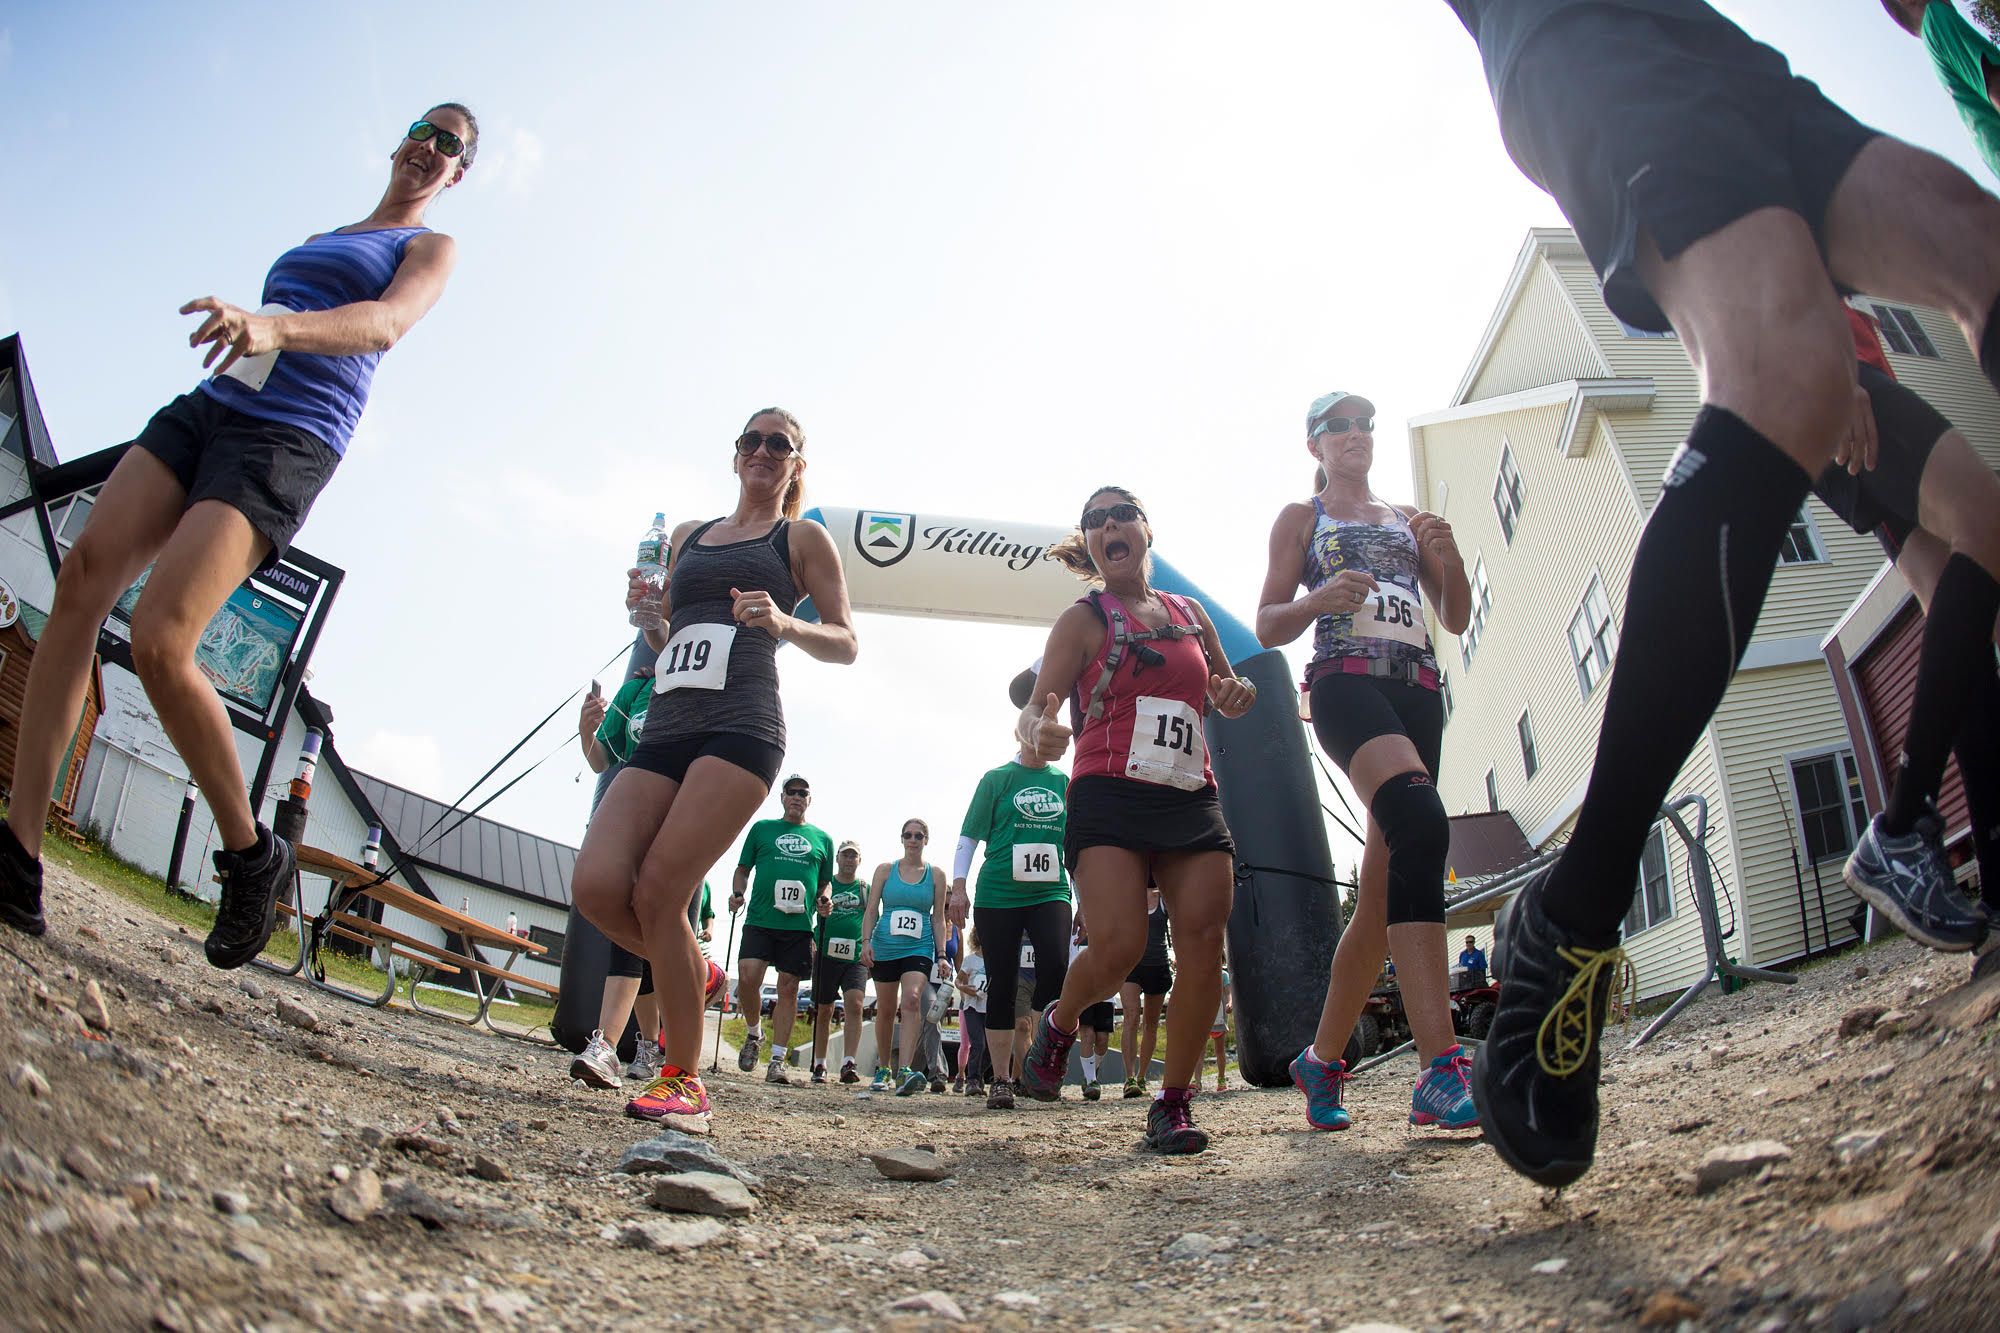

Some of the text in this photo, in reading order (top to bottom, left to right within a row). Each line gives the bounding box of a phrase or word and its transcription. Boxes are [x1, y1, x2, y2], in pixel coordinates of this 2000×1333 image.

[922, 526, 1062, 571] Killing
[1324, 524, 1347, 576] PW3
[263, 567, 310, 595] UNTAIN
[1373, 595, 1413, 628] 156
[666, 639, 712, 675] 119
[1153, 714, 1193, 756] 151
[1016, 793, 1047, 804] BOOT
[1024, 853, 1050, 872] 146
[781, 887, 800, 900] 179
[897, 916, 917, 931] 125
[834, 943, 850, 954] 126
